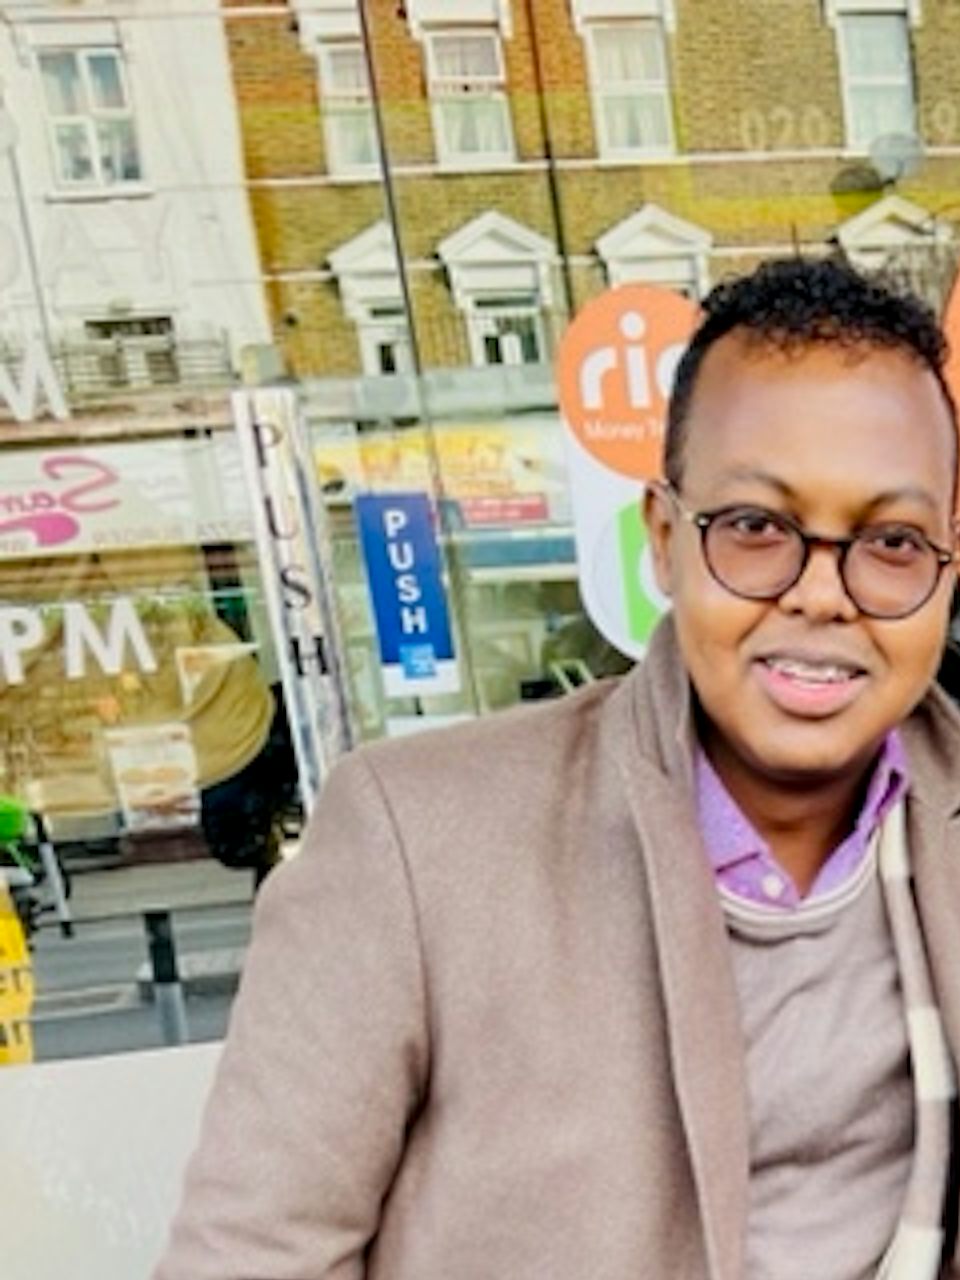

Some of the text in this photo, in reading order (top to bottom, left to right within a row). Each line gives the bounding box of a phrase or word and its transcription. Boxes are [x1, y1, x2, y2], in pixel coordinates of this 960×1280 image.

[252, 423, 330, 677] PUSH
[383, 509, 429, 634] PUSH
[0, 598, 158, 686] PM
